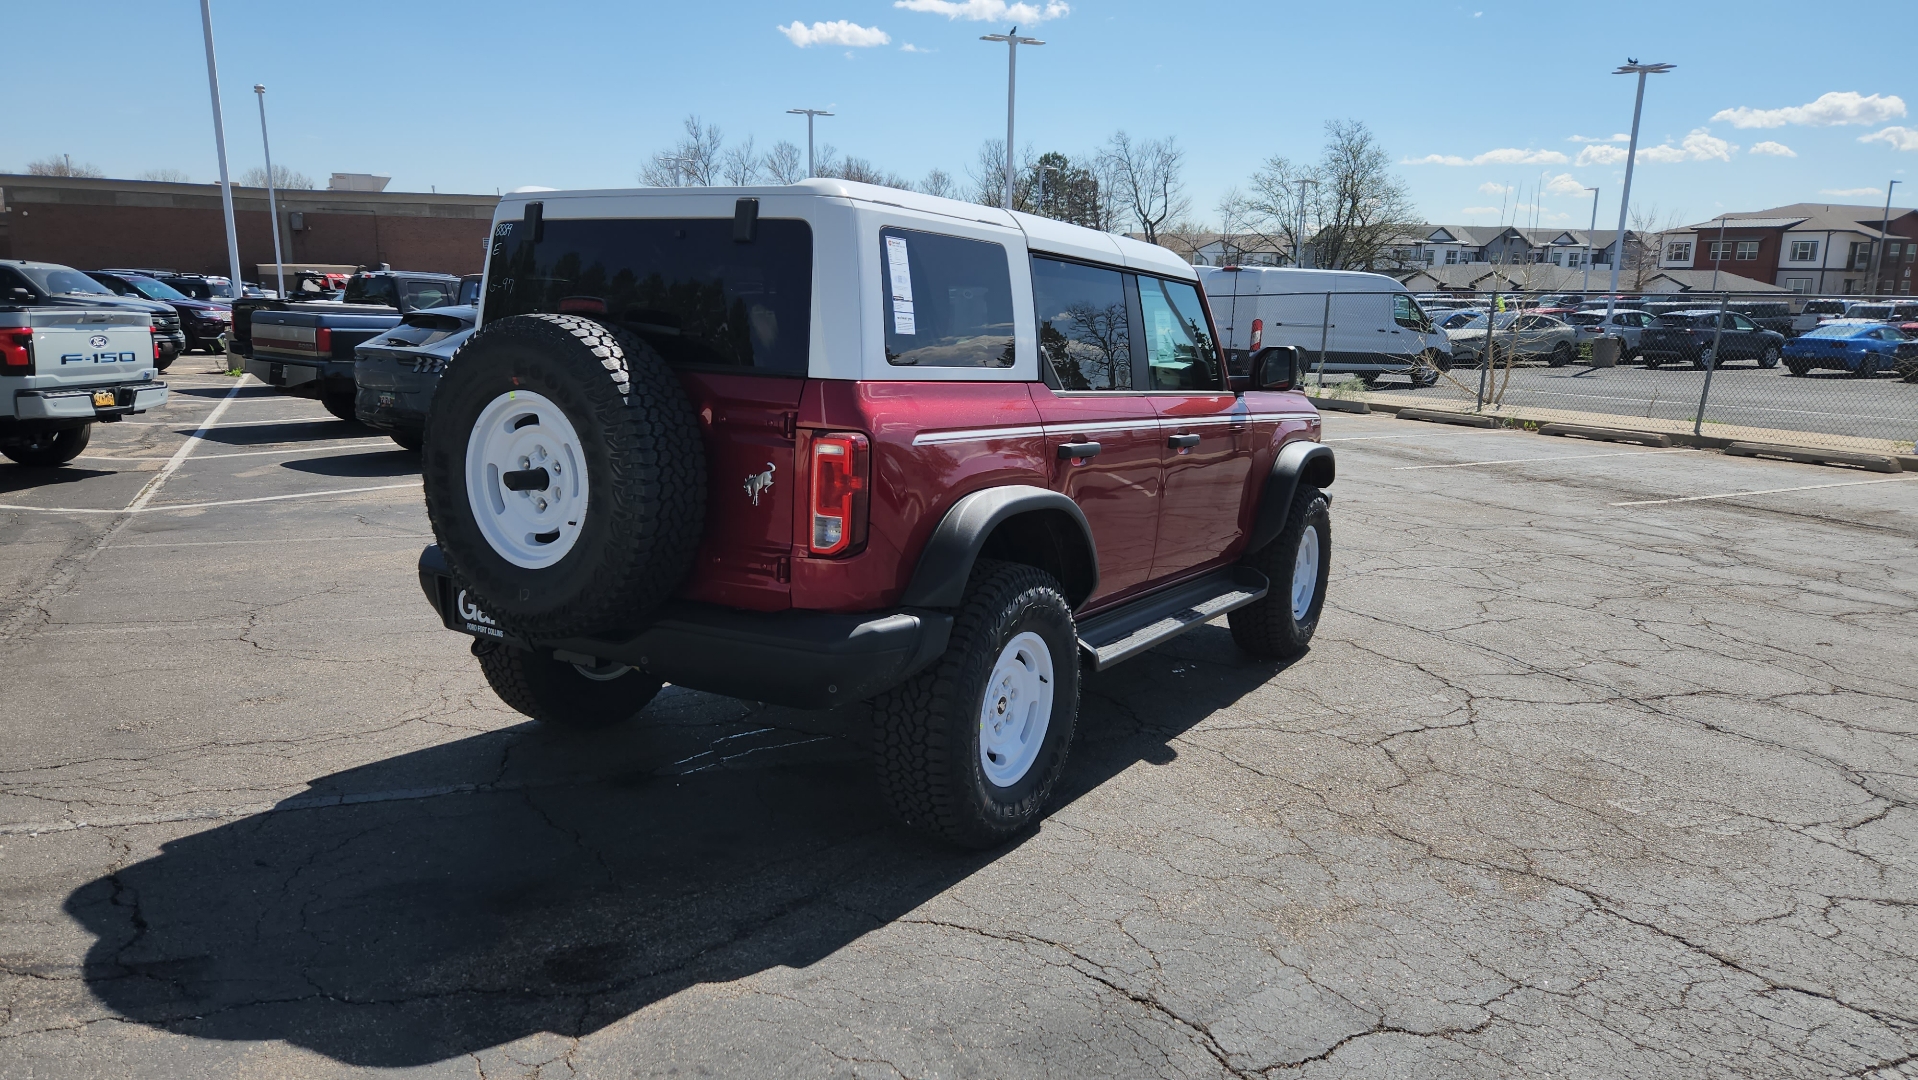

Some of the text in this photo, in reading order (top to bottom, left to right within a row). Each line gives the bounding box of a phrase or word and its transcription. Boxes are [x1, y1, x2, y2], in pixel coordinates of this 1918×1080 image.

[60, 351, 135, 365] F-150
[466, 622, 504, 638] FORD FORT COLLINS
